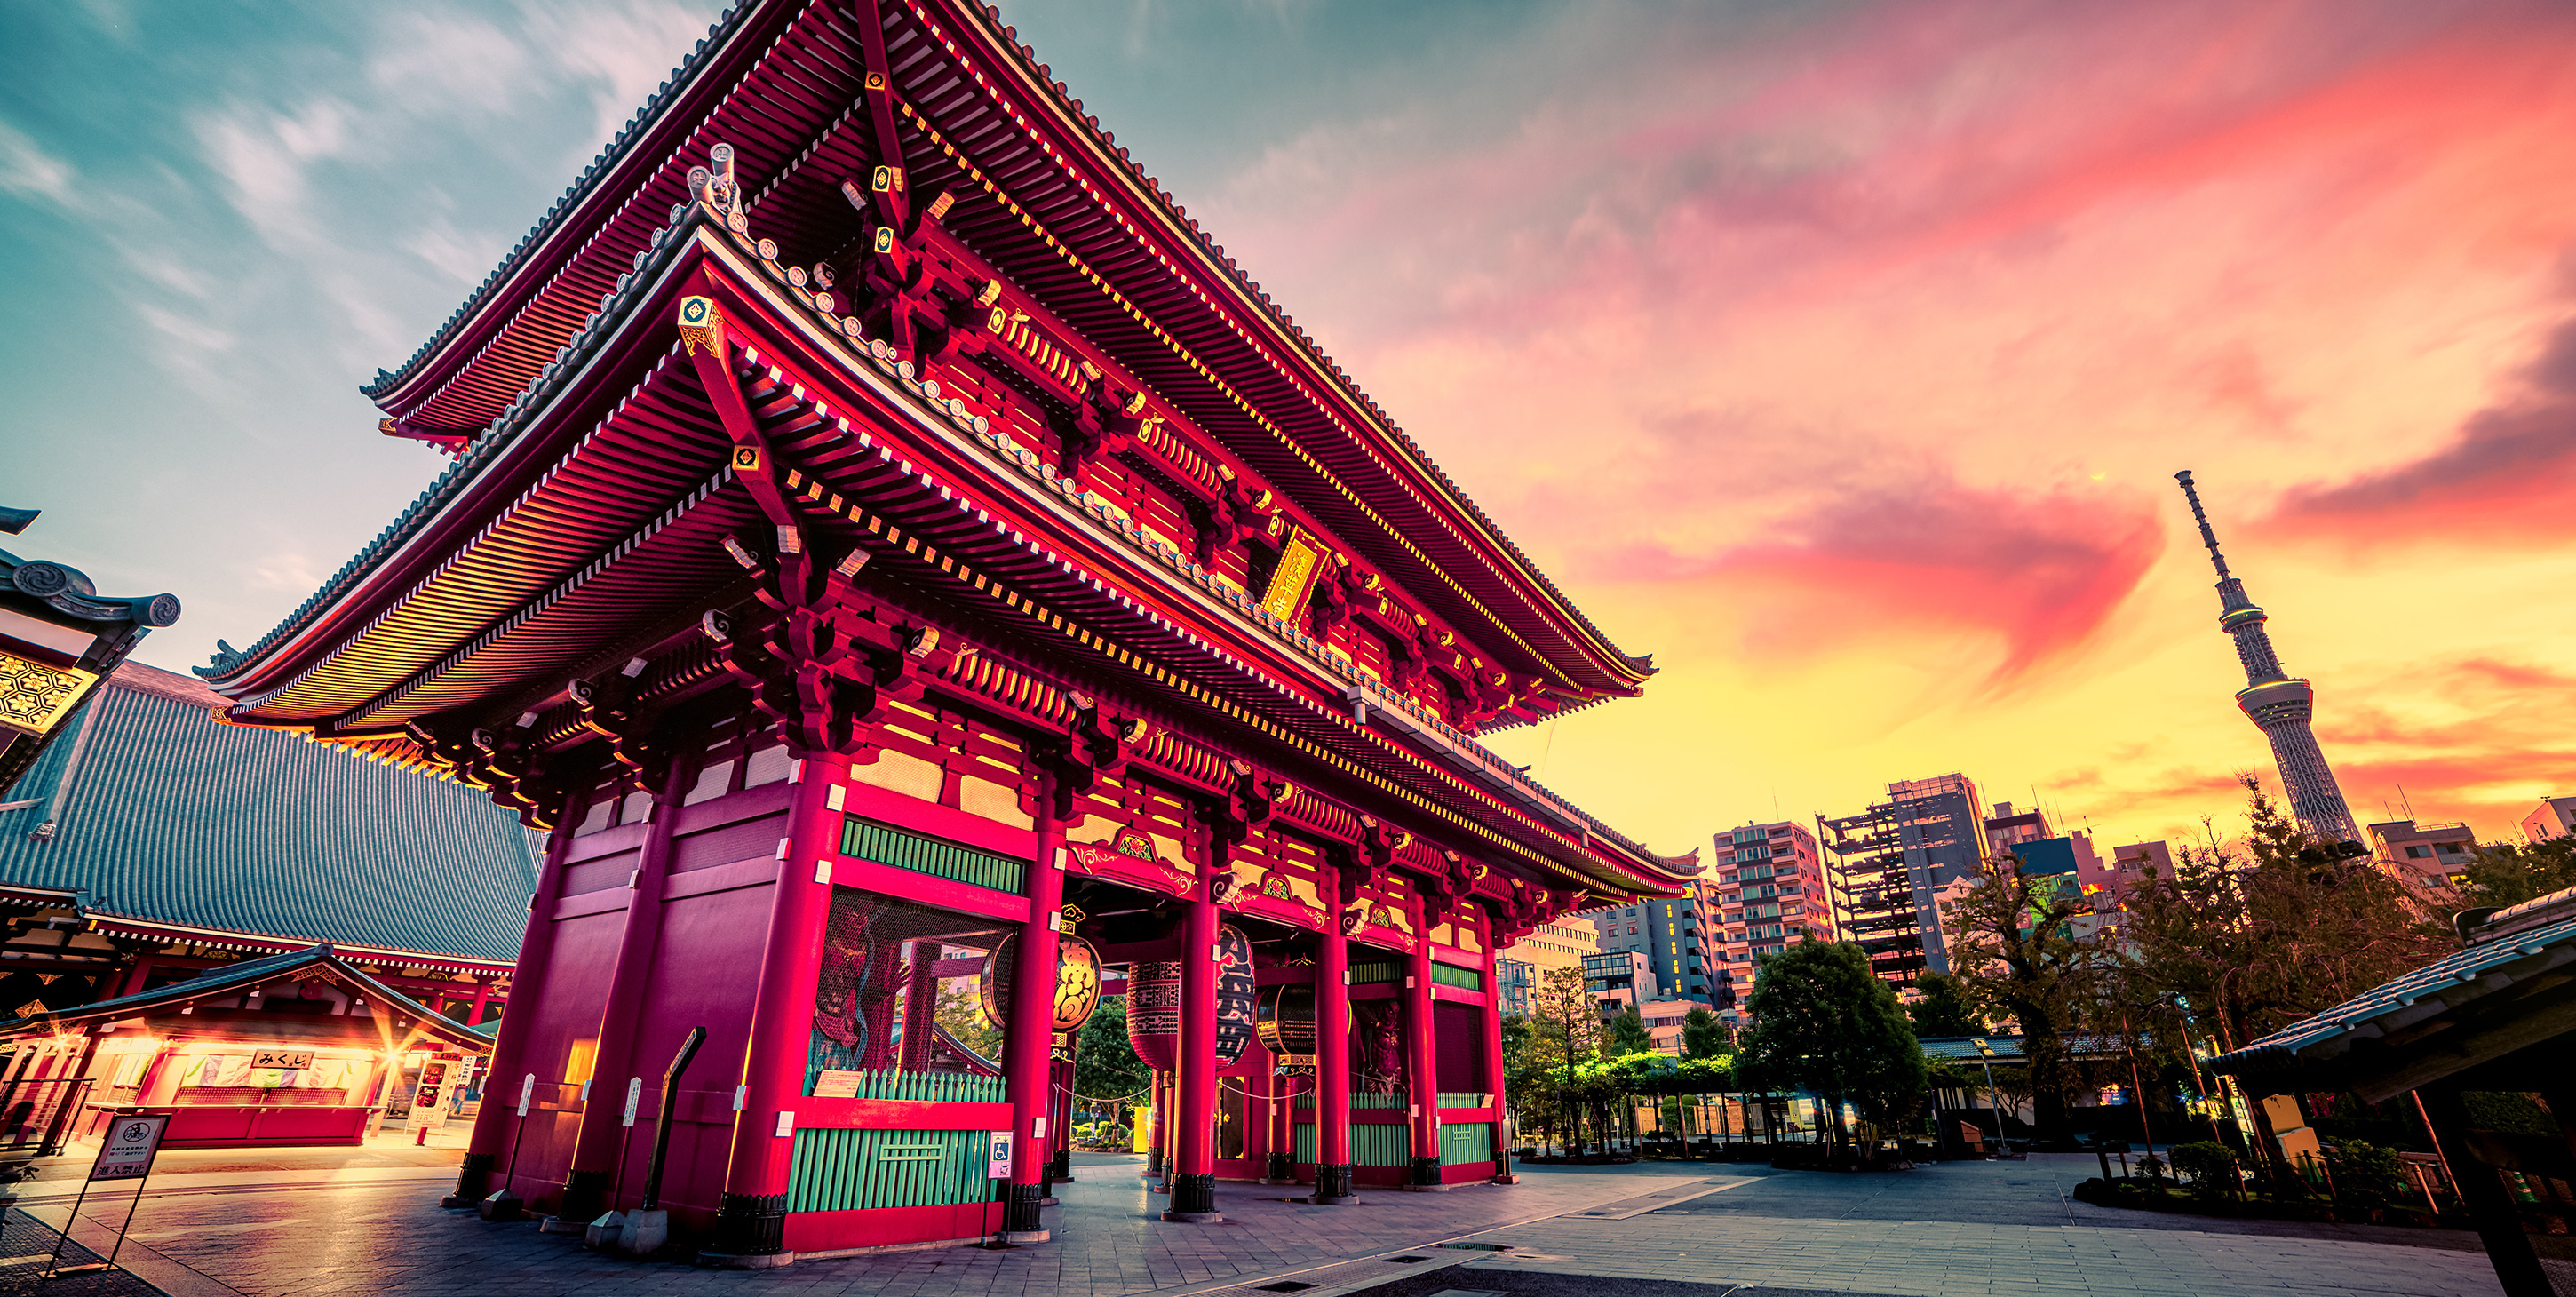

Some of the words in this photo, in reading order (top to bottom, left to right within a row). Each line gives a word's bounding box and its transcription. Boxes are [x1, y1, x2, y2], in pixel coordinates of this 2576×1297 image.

[259, 1054, 306, 1065] みくじ
[97, 1165, 145, 1176] 進入禁止
